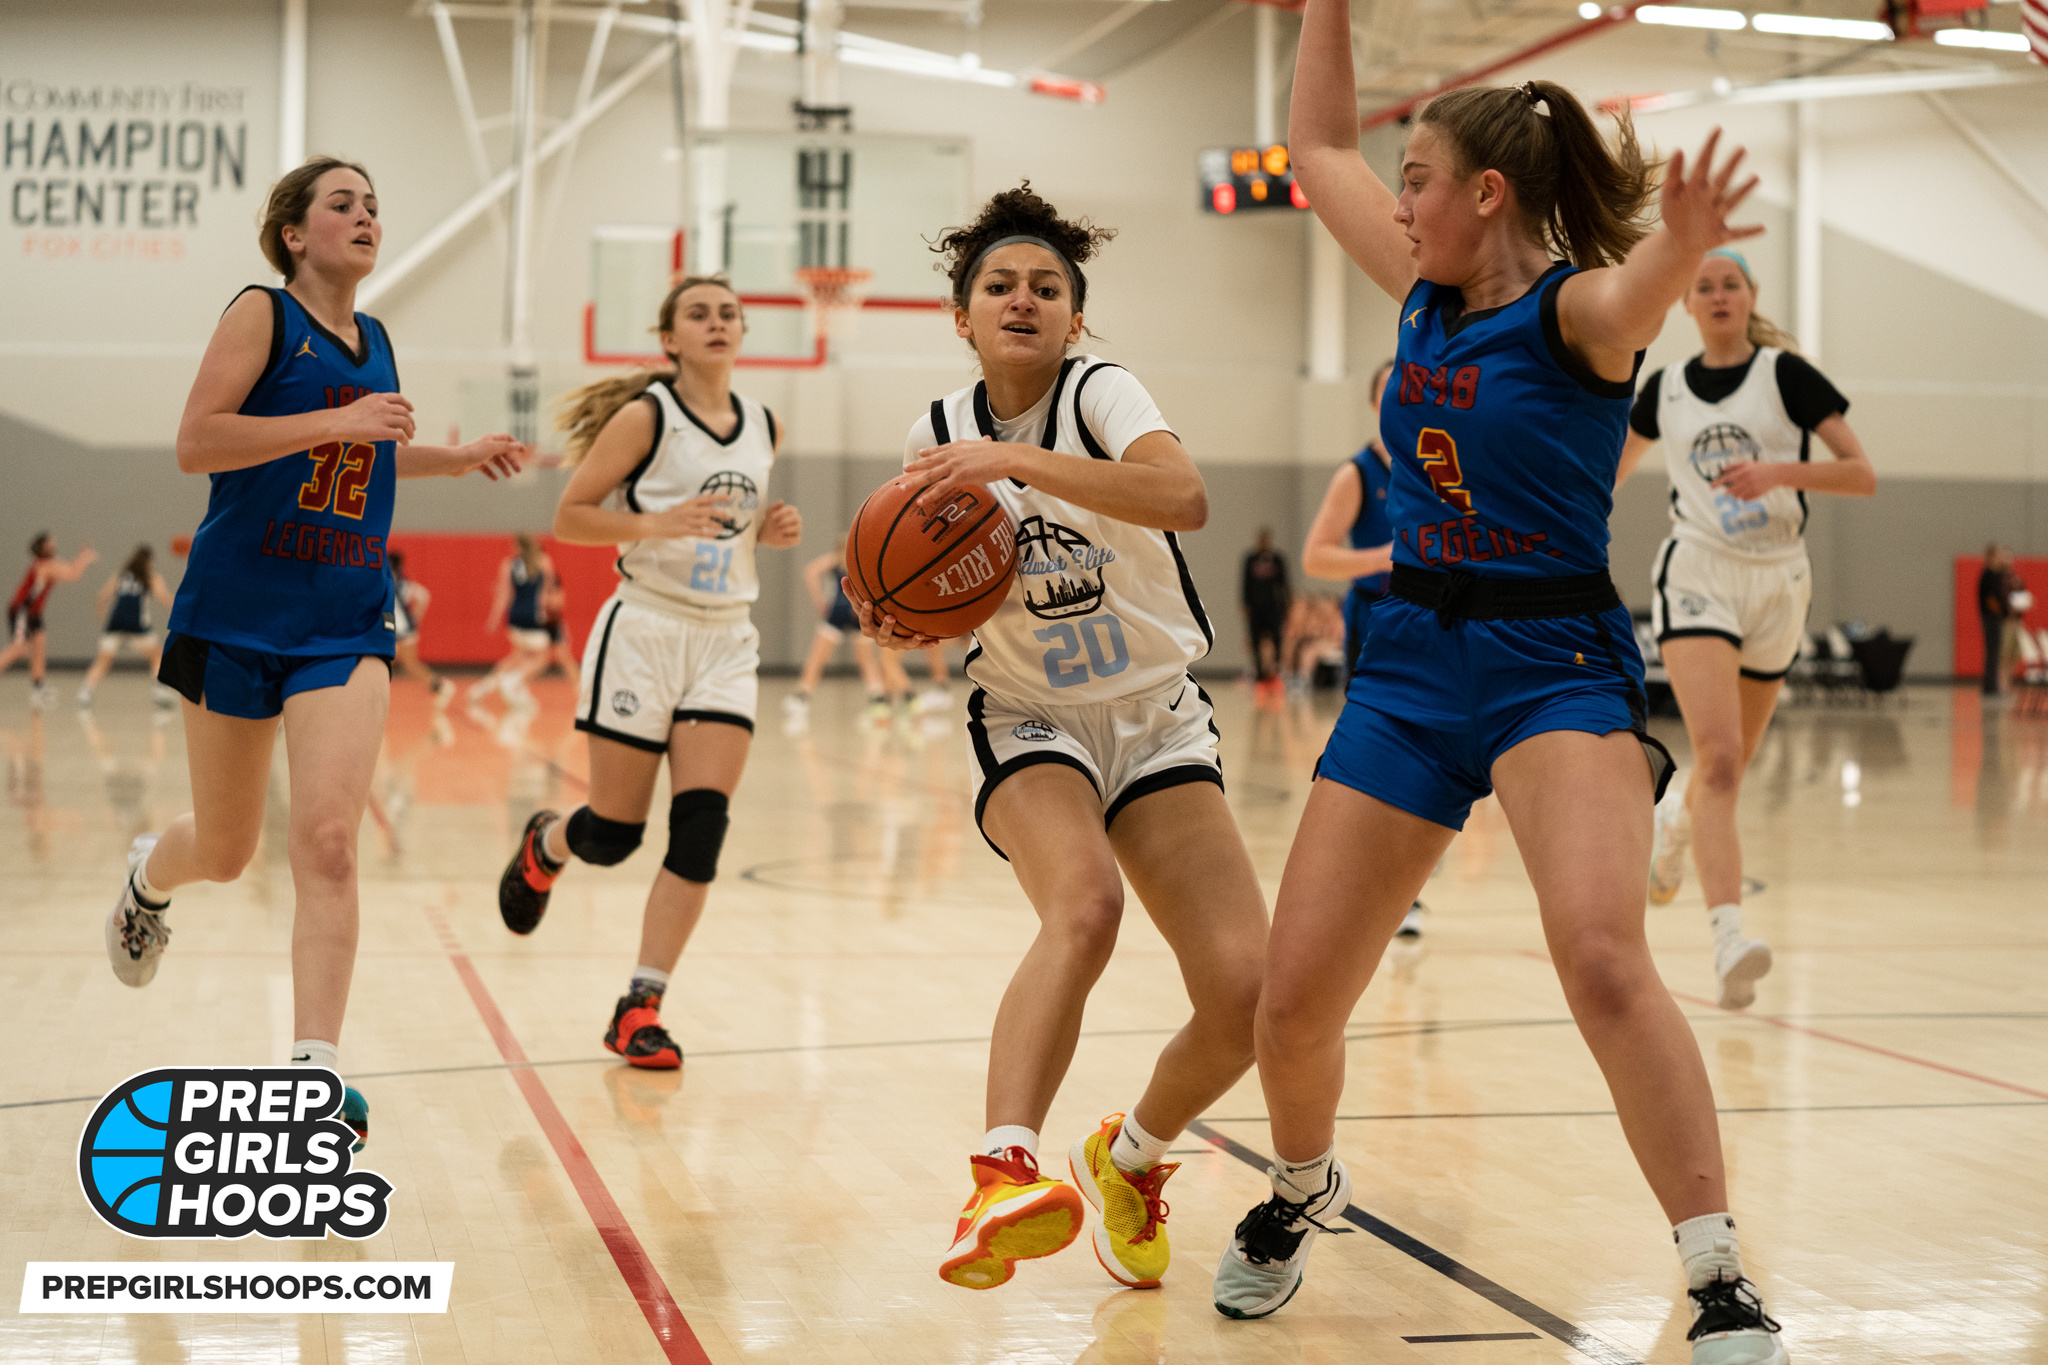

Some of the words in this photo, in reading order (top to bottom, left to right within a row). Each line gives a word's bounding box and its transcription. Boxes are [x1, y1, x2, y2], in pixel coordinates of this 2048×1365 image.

[11, 179, 201, 228] CENTER
[23, 232, 81, 260] FOX
[91, 232, 187, 261] CITIES
[323, 384, 373, 409] 18
[298, 441, 376, 519] 32
[1416, 427, 1478, 516] 2
[261, 519, 384, 570] LEGENDS
[690, 543, 733, 593] 21
[930, 542, 996, 597] ROCK
[1071, 544, 1116, 571] Elite
[1032, 613, 1131, 689] 20
